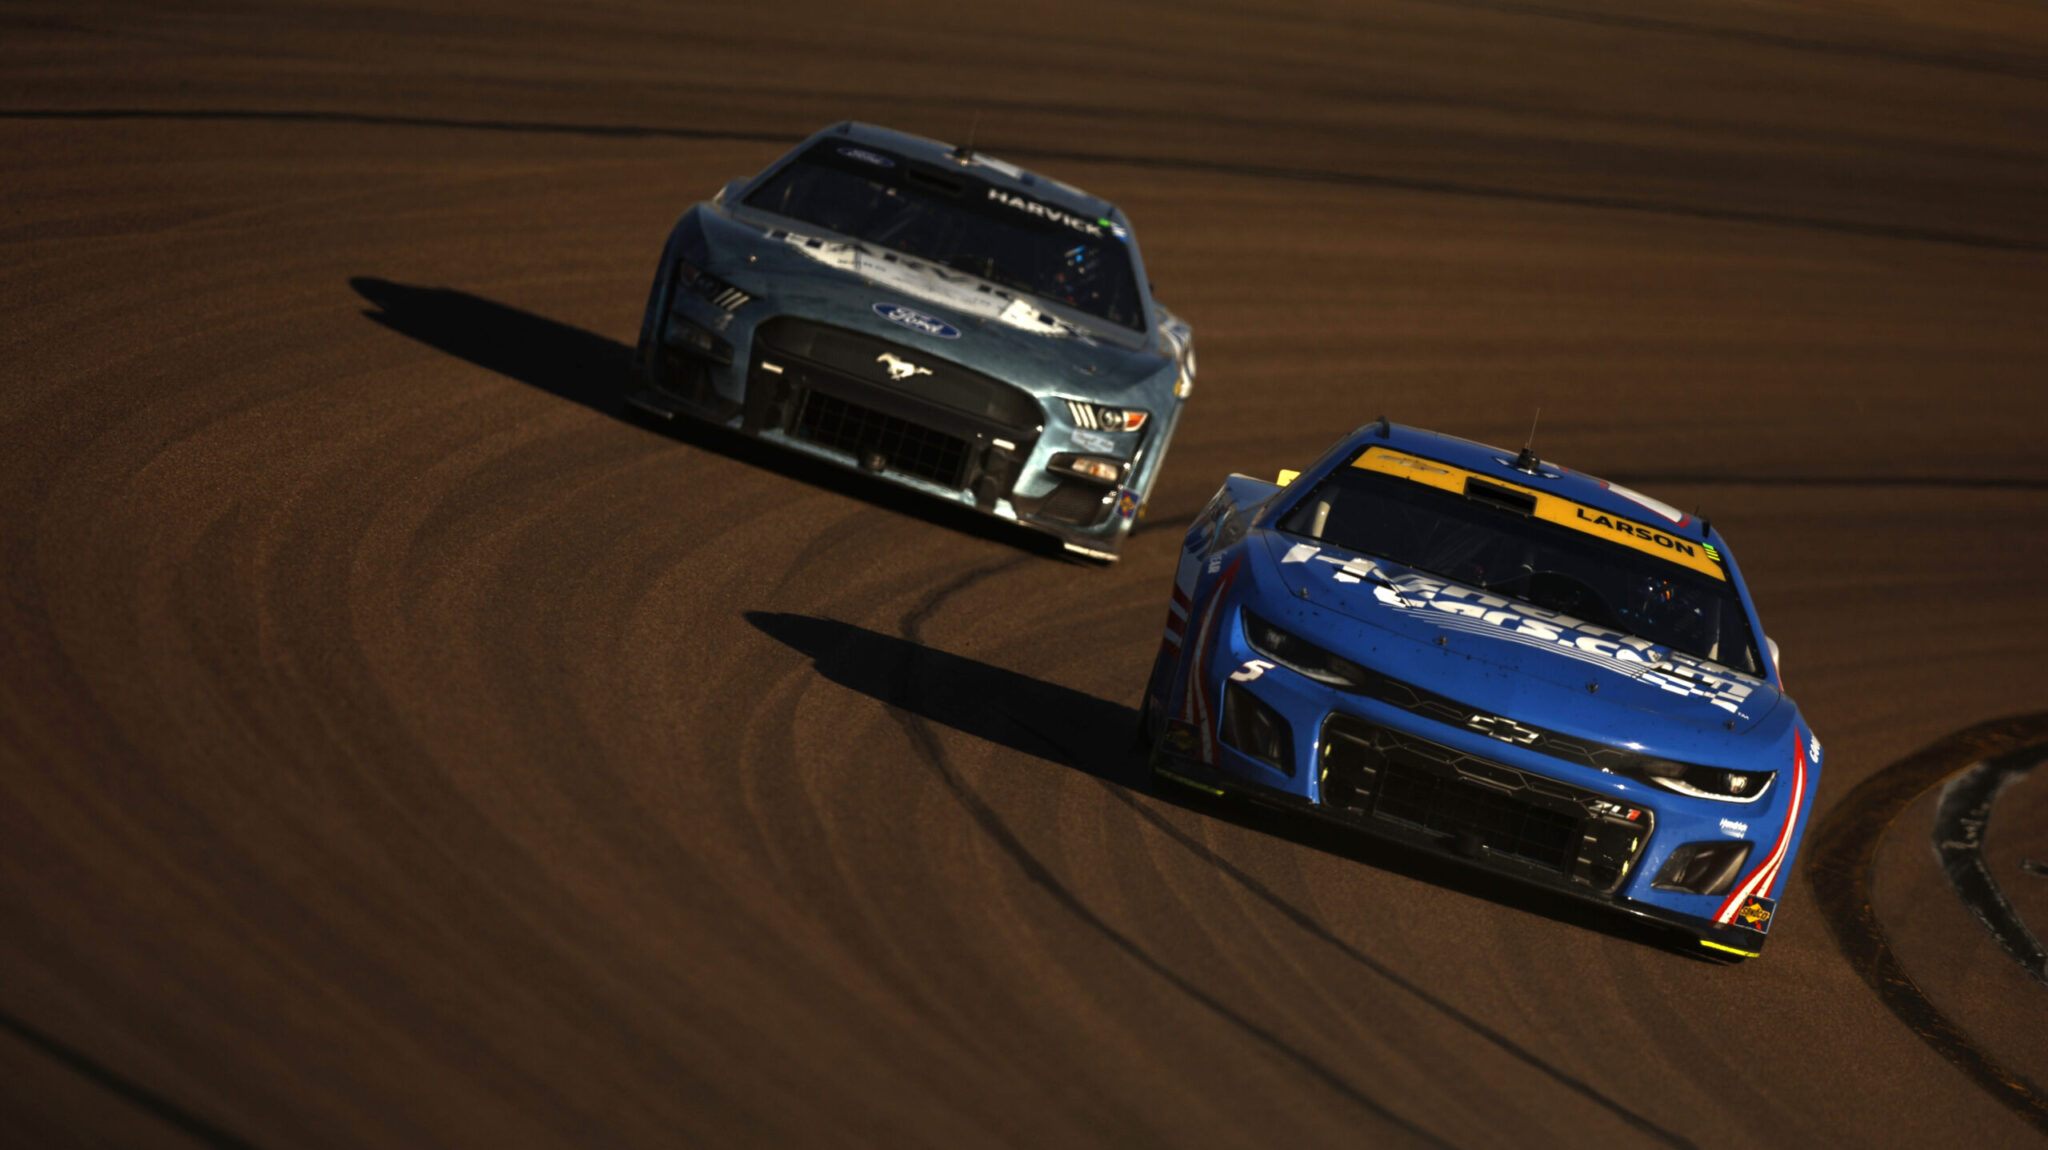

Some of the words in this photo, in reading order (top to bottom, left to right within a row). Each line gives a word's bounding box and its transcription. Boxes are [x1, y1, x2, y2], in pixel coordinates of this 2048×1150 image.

[987, 187, 1105, 240] HARVICK
[887, 306, 945, 333] Ford
[1576, 508, 1695, 557] LARSON
[1229, 659, 1276, 682] 5
[1589, 800, 1641, 820] ZL1
[1740, 905, 1770, 921] SUNOCO
